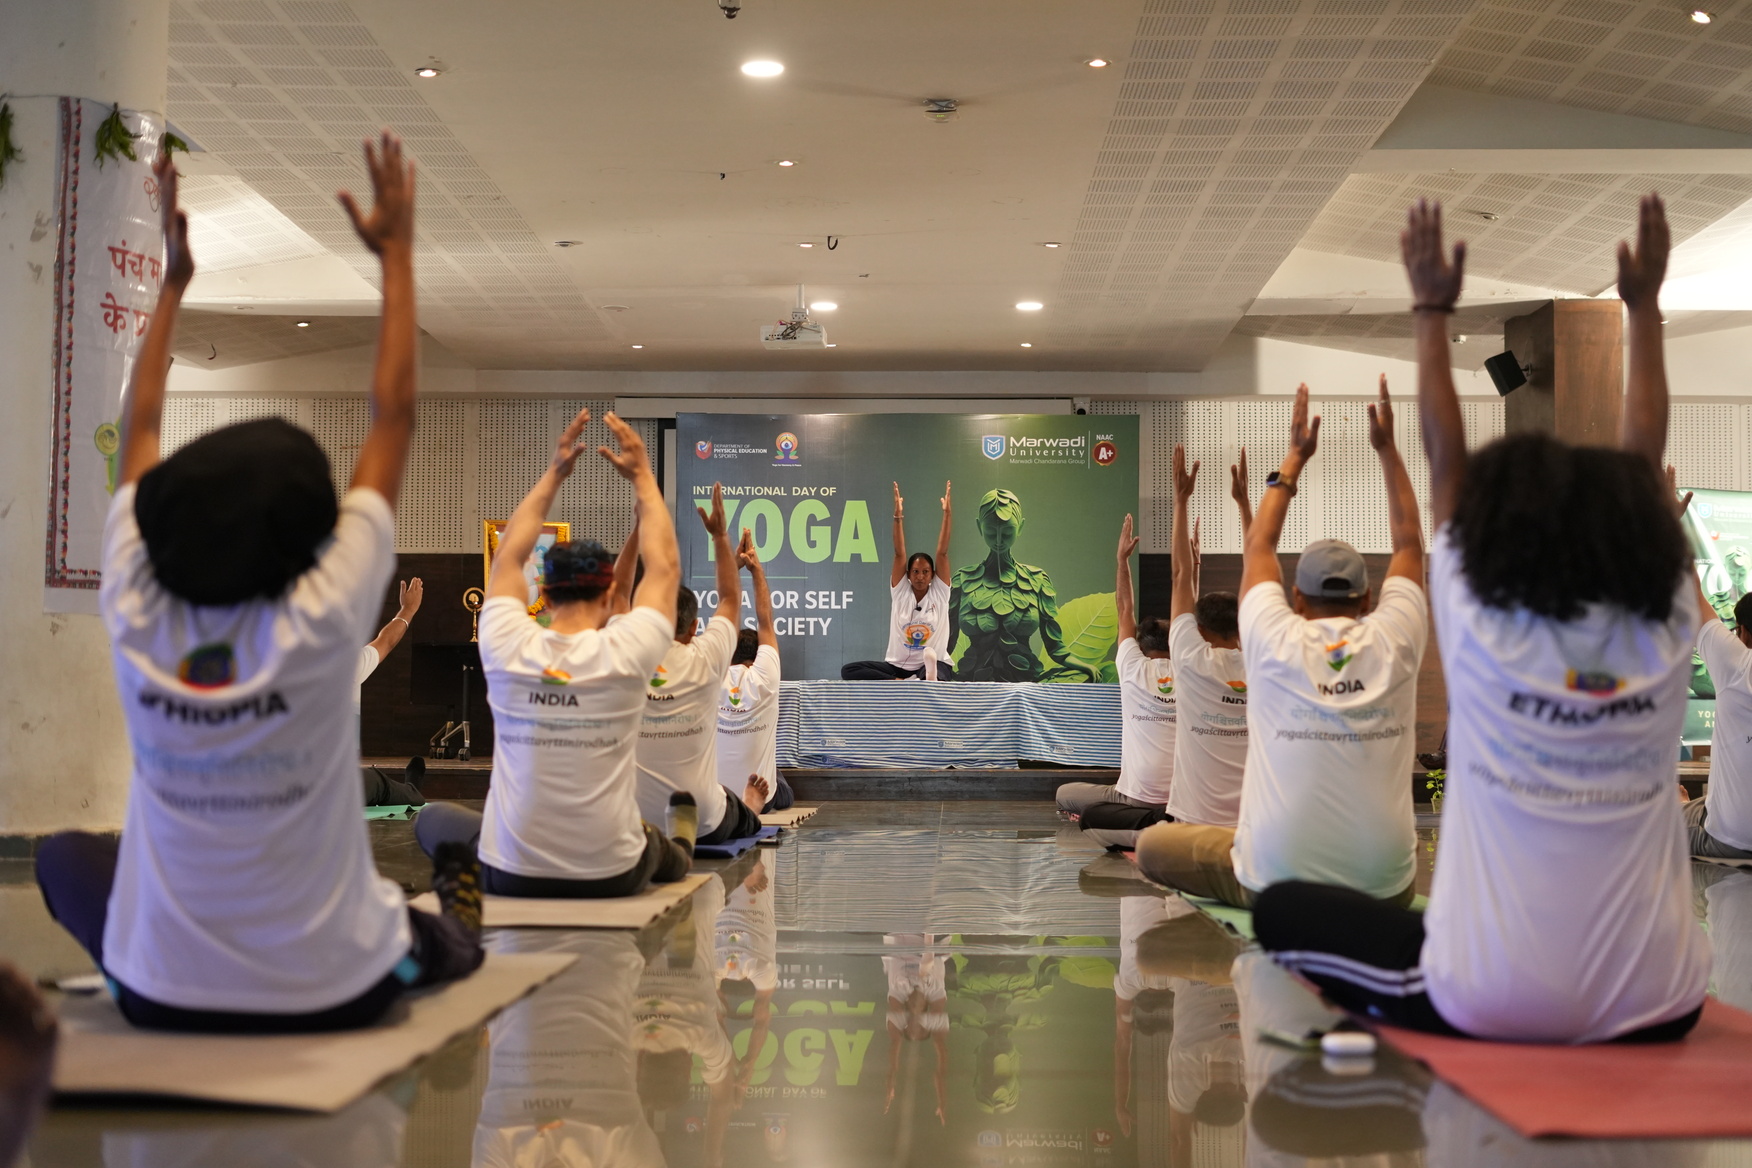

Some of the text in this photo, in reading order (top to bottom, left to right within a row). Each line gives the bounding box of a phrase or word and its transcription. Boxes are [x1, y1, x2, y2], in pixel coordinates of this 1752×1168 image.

[1010, 436, 1085, 447] Marwadi
[1010, 448, 1085, 458] University
[1098, 447, 1114, 460] A+
[692, 485, 837, 496] INTRNATIONAL DAY OF
[694, 590, 854, 610] YOA OR SELF
[743, 617, 832, 636] SCIETY
[1318, 679, 1365, 696] INDIA
[528, 691, 580, 707] INDIA
[646, 692, 675, 701] NDIA
[1221, 695, 1247, 705] INDI
